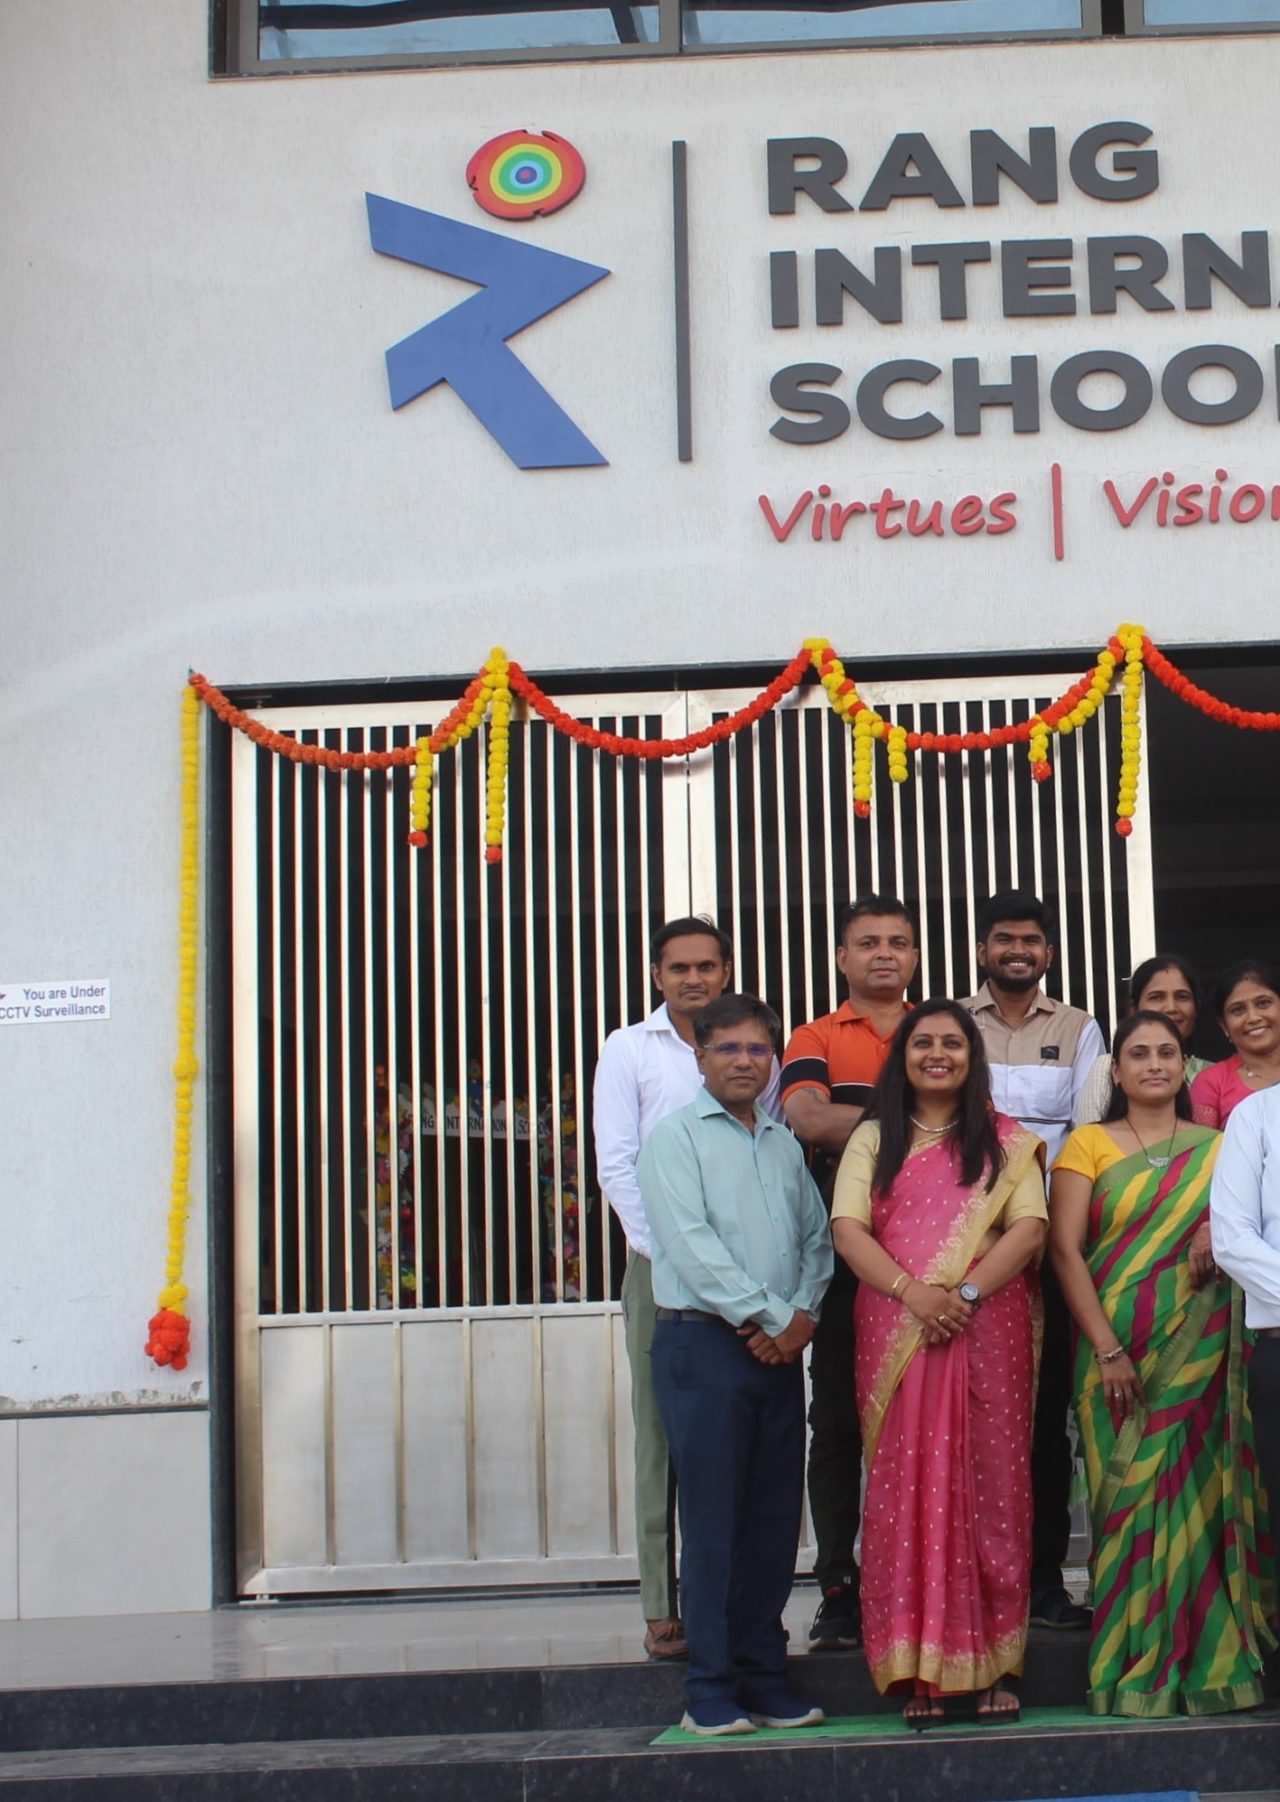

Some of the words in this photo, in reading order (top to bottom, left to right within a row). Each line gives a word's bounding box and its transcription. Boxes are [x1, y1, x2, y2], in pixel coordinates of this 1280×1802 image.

[766, 120, 1161, 216] RANG
[758, 484, 1018, 543] Virtues
[0, 1006, 31, 1019] CCTV
[34, 1003, 106, 1018] Surveillance
[23, 988, 46, 1001] You
[48, 989, 67, 1000] are
[70, 984, 106, 999] Under
